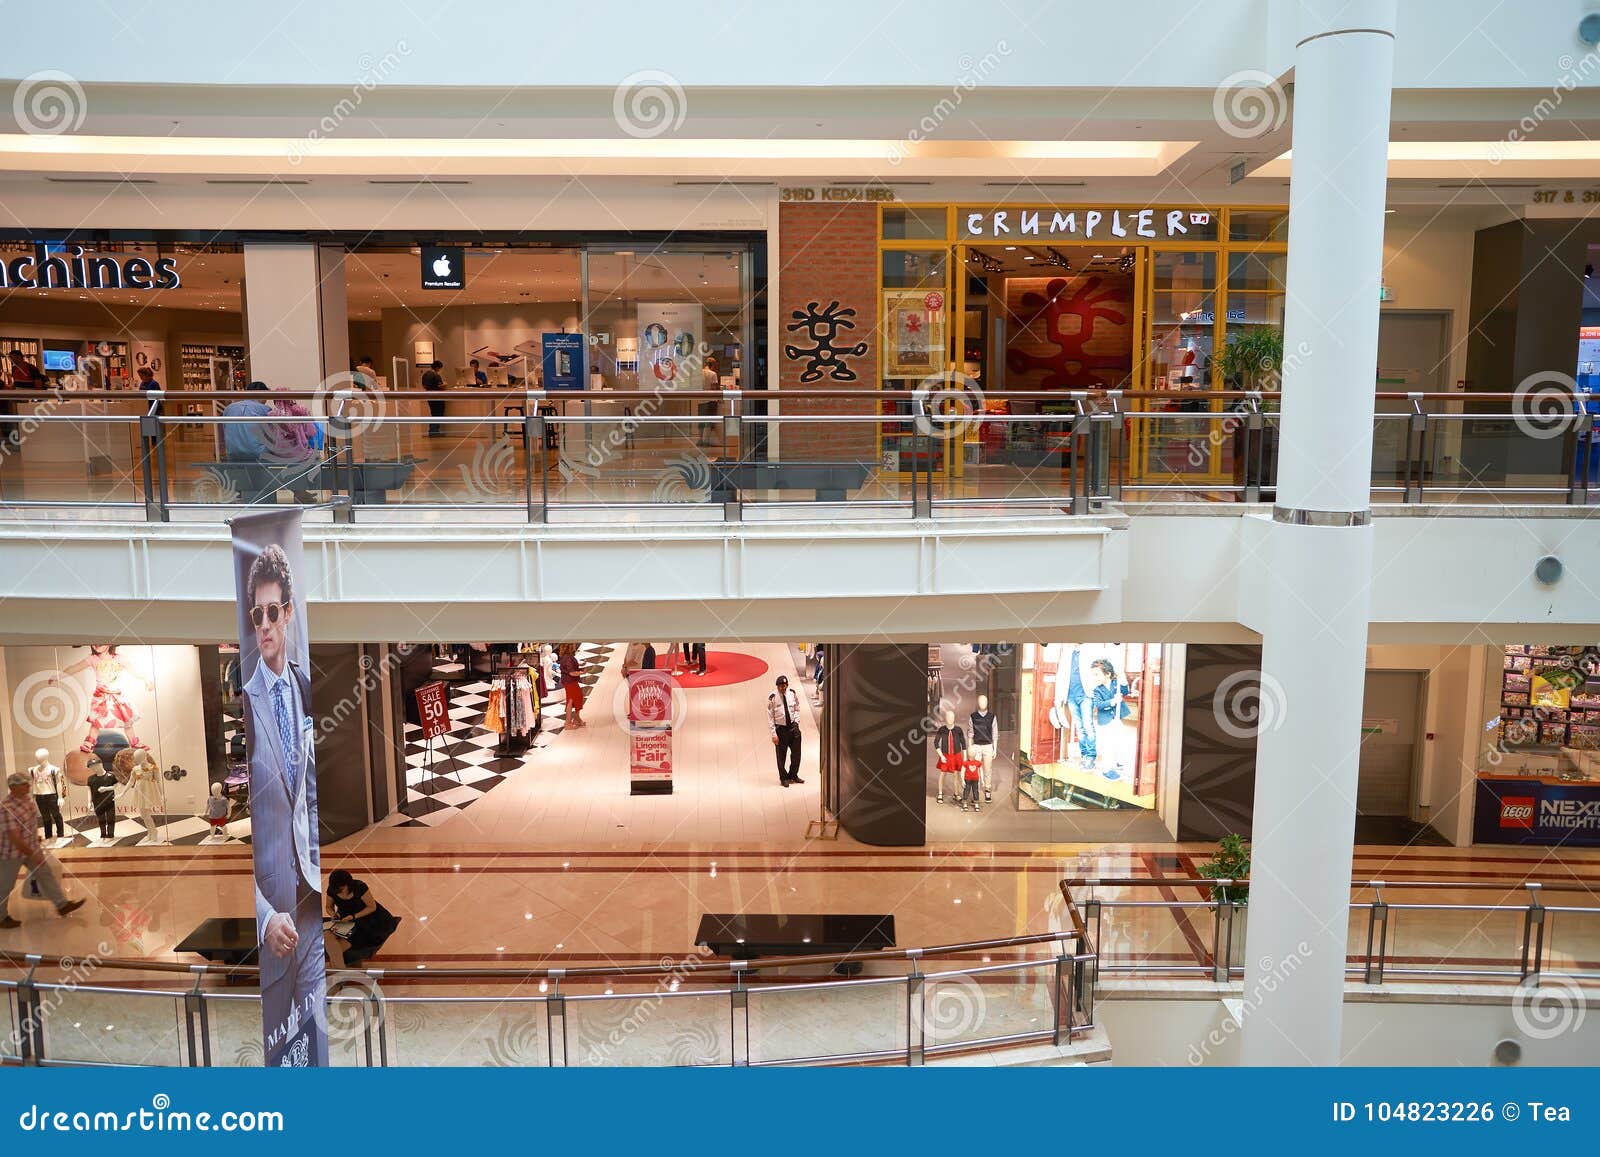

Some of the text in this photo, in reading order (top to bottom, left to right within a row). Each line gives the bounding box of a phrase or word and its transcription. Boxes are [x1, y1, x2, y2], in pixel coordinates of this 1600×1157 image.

[1532, 191, 1558, 203] 317
[1563, 191, 1574, 203] &
[967, 209, 1188, 239] CRUMPLER
[422, 690, 441, 705] SALE
[424, 700, 443, 721] 50
[635, 734, 667, 742] Branded
[635, 742, 668, 751] Lingerie
[636, 749, 667, 762] Fair
[1502, 805, 1534, 819] LEGO
[1540, 814, 1600, 829] KNIGHT
[267, 1003, 302, 1052] MADE
